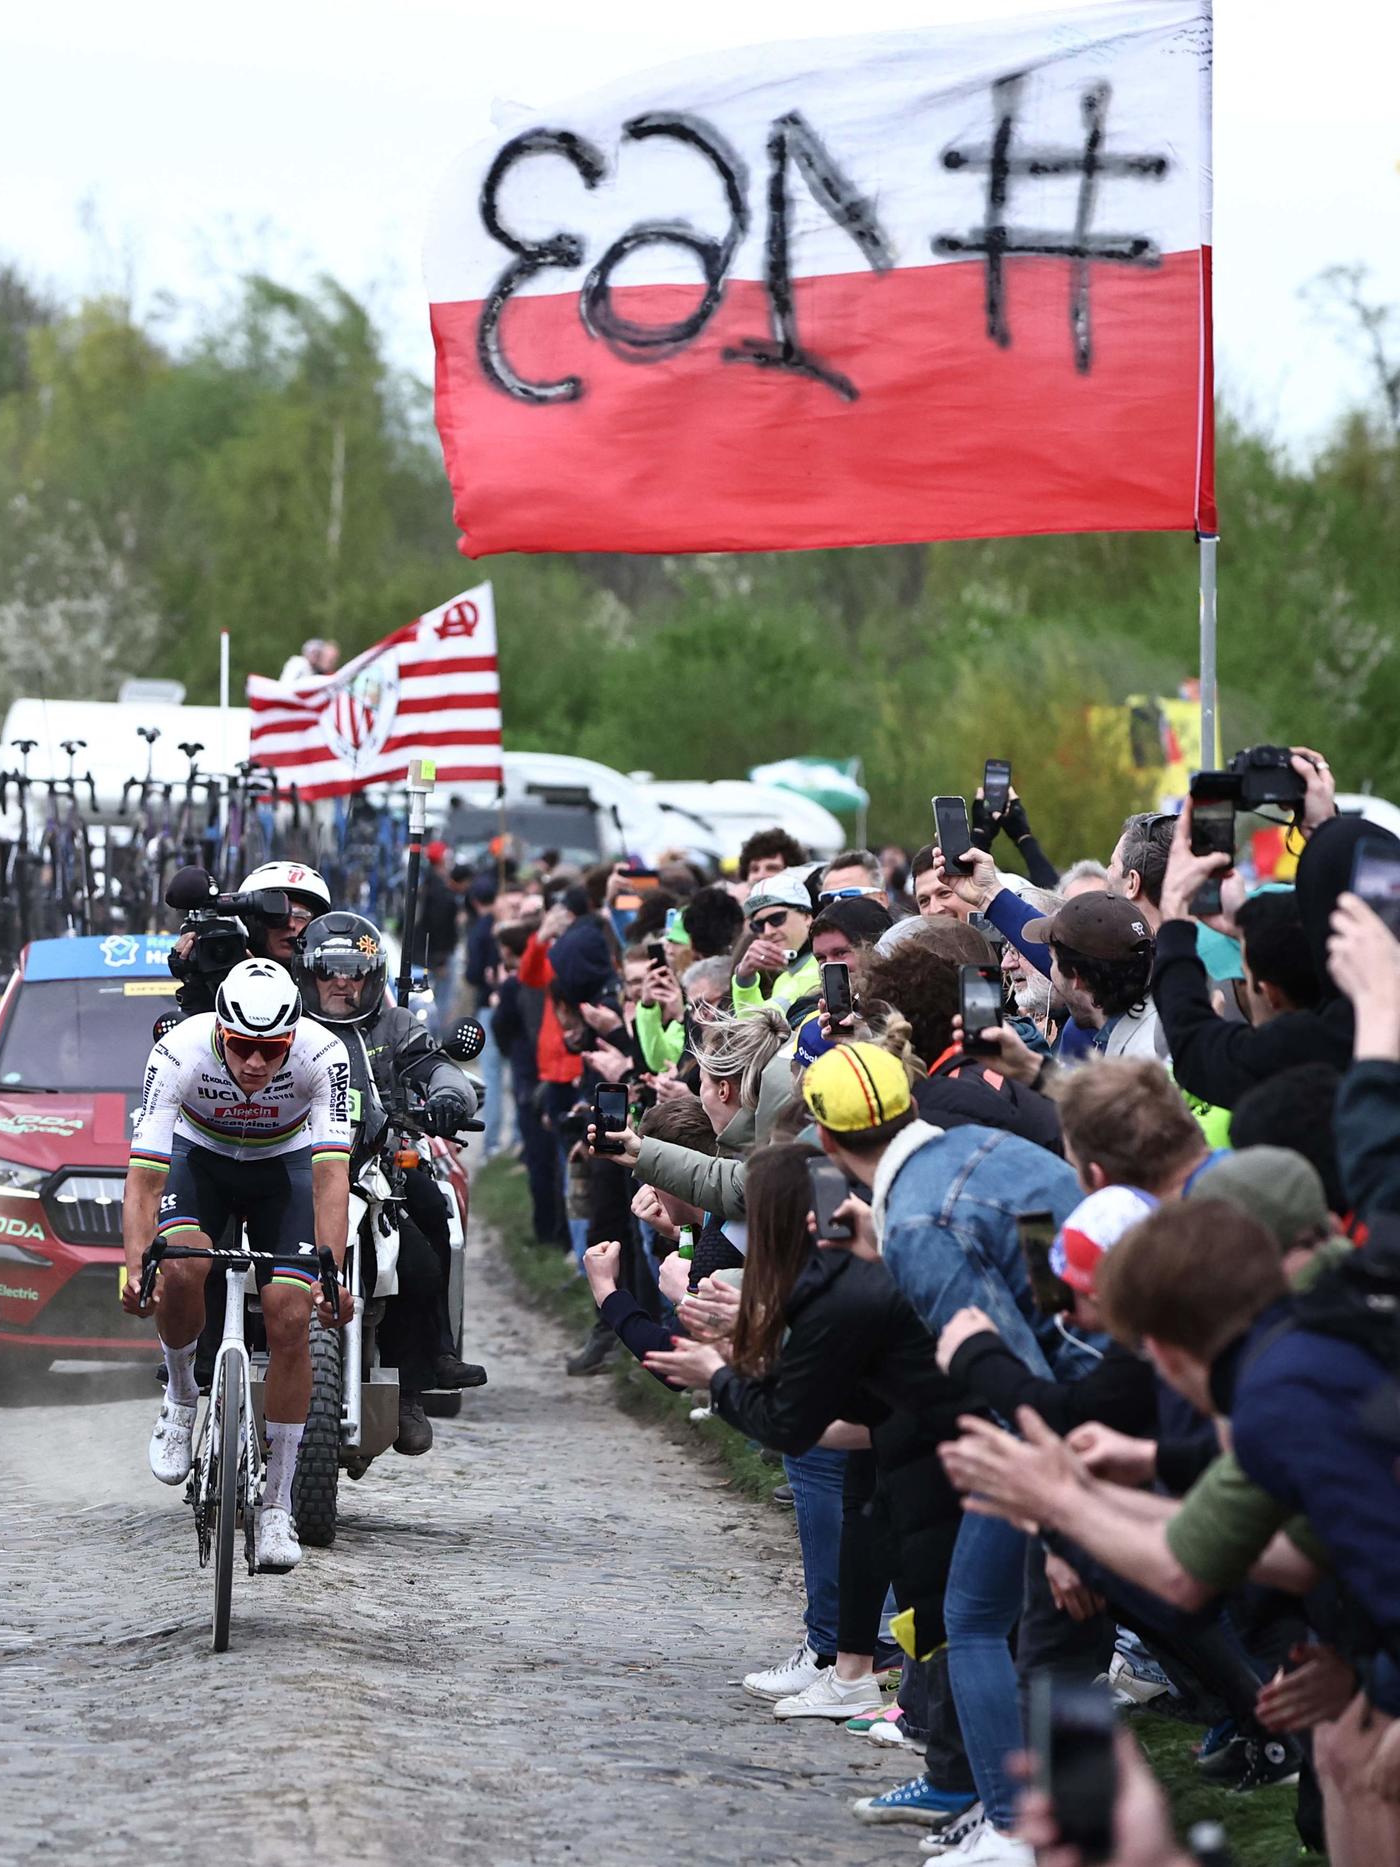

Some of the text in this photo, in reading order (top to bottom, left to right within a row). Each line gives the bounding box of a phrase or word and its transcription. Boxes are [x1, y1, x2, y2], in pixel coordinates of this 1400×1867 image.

[204, 1087, 240, 1102] UCI
[330, 1062, 349, 1122] Alpecin
[222, 1107, 272, 1118] Alpecin
